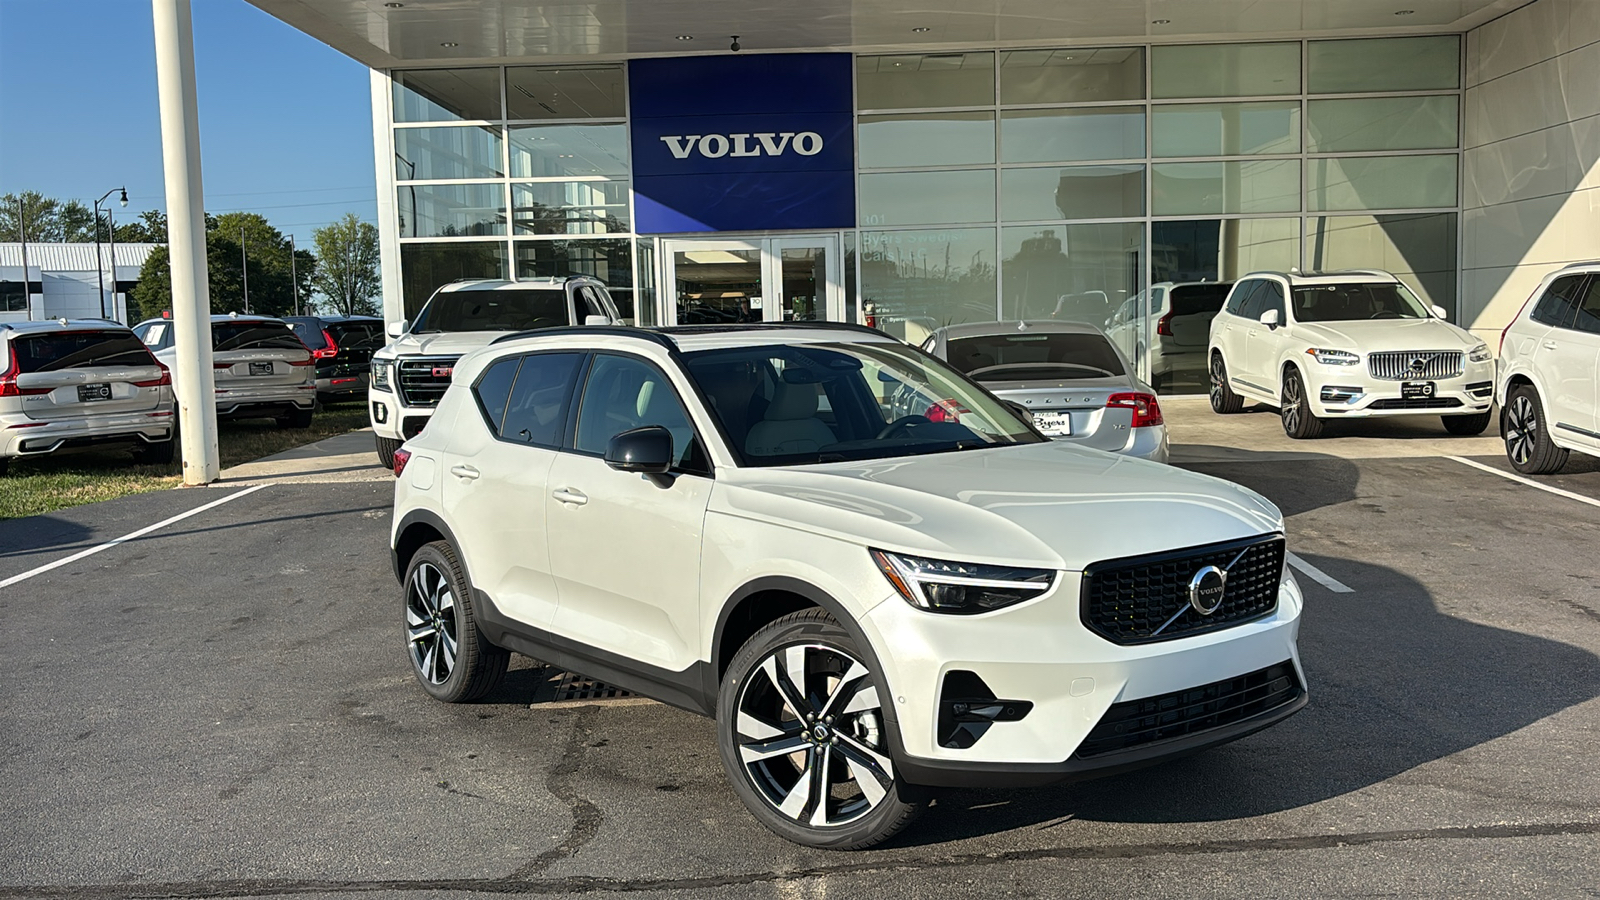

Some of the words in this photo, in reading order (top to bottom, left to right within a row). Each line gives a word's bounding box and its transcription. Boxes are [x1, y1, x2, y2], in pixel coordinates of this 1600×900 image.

[660, 131, 824, 159] VOLVO
[863, 231, 901, 247] Byers
[862, 250, 895, 262] Cars
[1034, 418, 1065, 430] Byers
[1200, 586, 1223, 596] VOLVO
